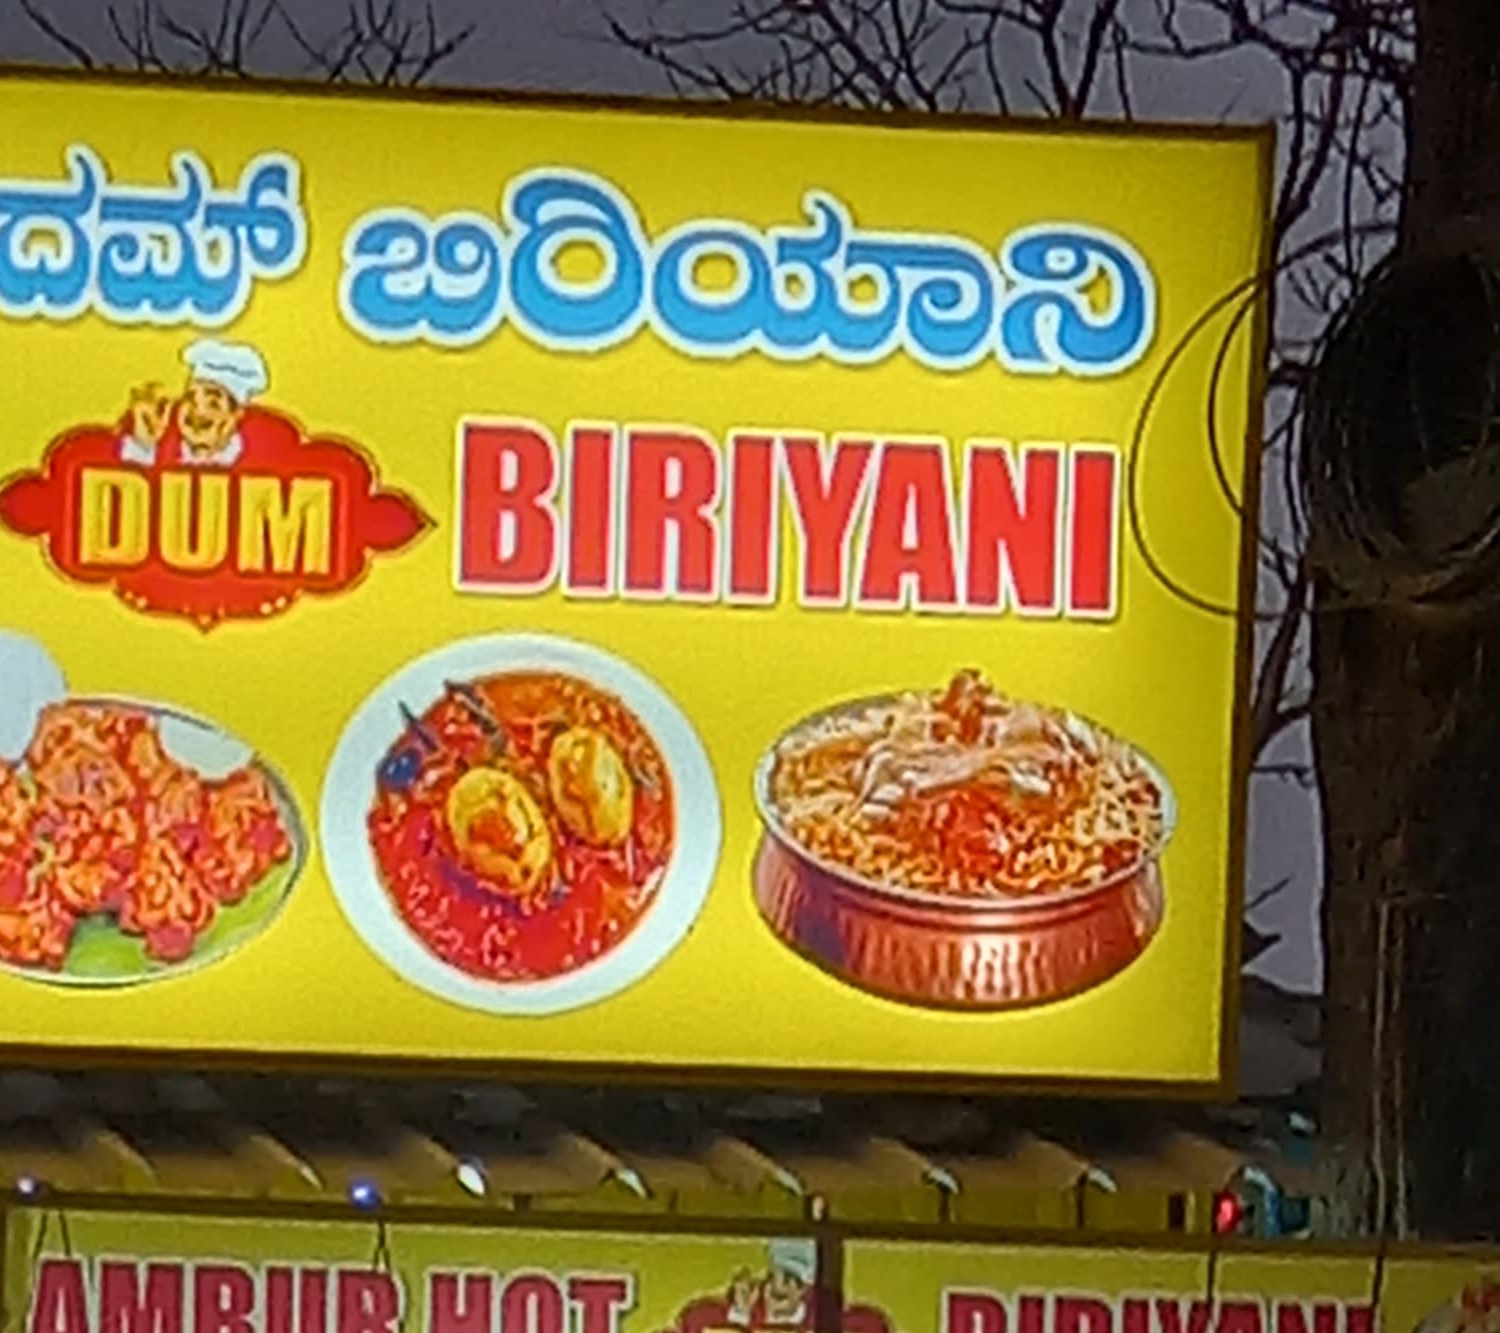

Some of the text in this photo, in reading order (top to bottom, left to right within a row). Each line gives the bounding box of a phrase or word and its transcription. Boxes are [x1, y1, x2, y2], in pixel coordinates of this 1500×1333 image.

[346, 174, 1148, 368] ಬಿರಿಯಾನಿ
[78, 466, 332, 576] DUM
[458, 421, 1118, 612] BIRIYANI
